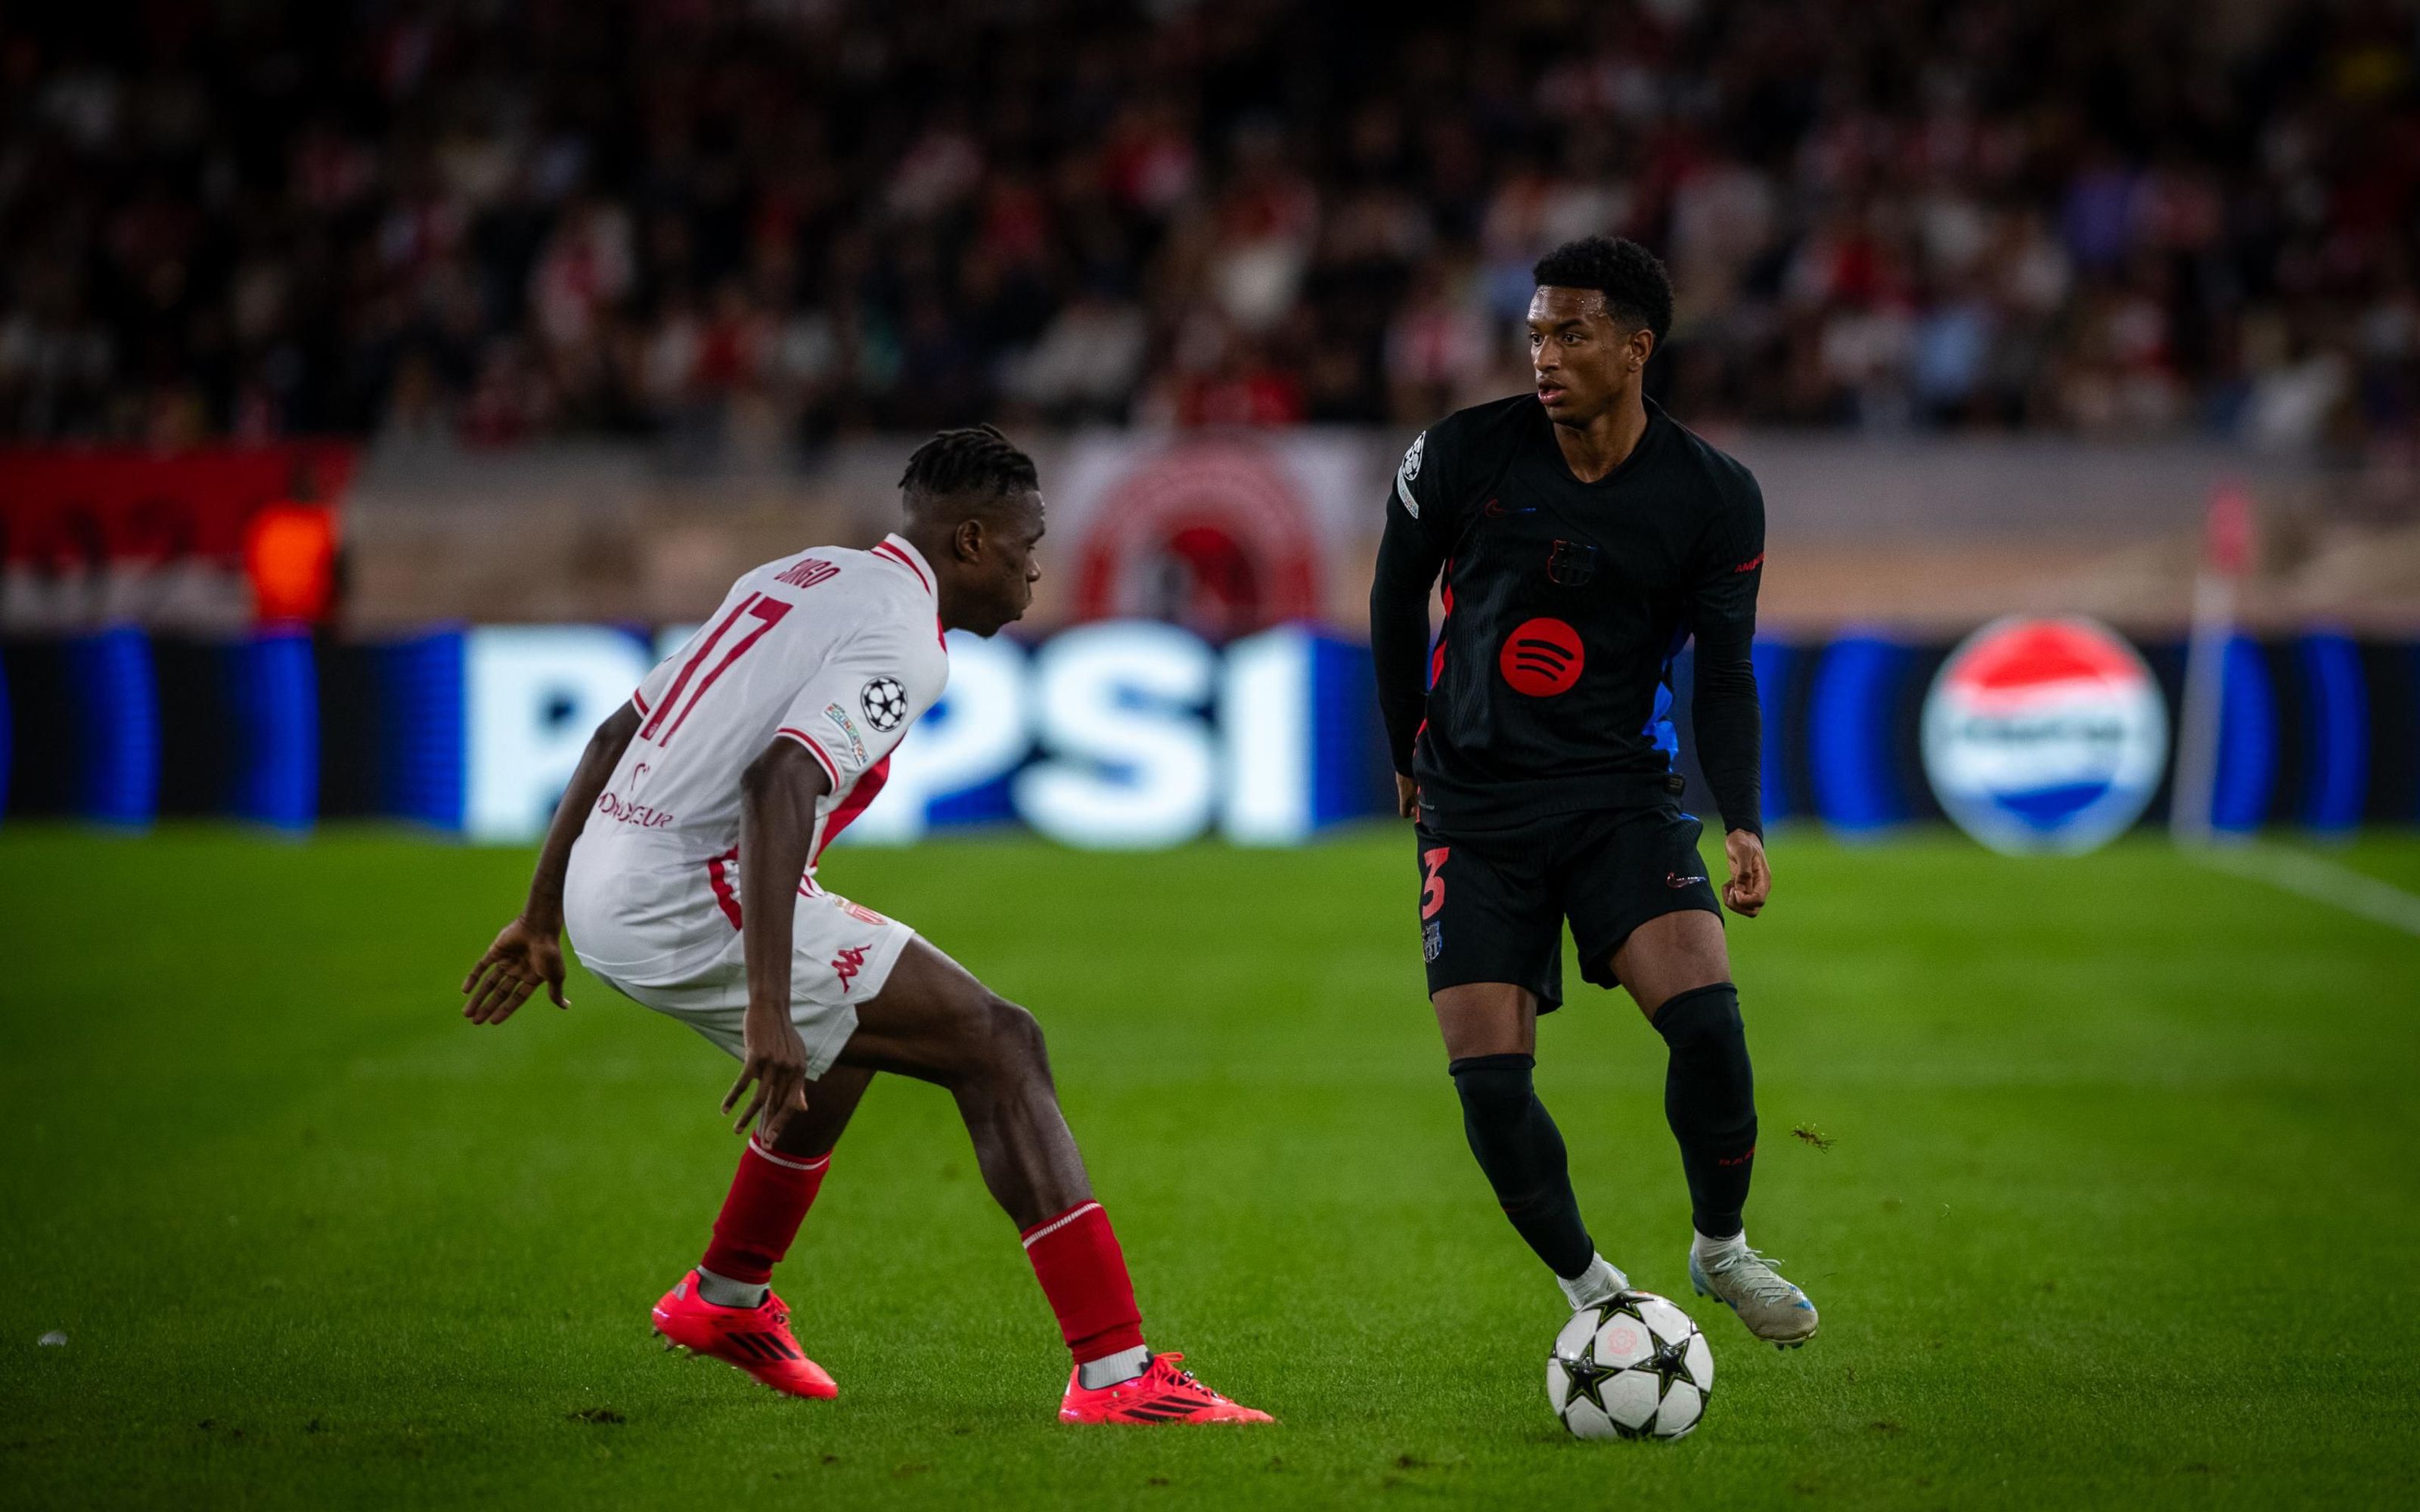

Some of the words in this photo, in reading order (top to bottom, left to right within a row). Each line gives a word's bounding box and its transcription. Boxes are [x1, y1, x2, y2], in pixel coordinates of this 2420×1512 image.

[774, 558, 841, 589] SINGO
[640, 591, 794, 748] 17
[463, 618, 1314, 848] PPSI
[1422, 847, 1451, 920] 3
